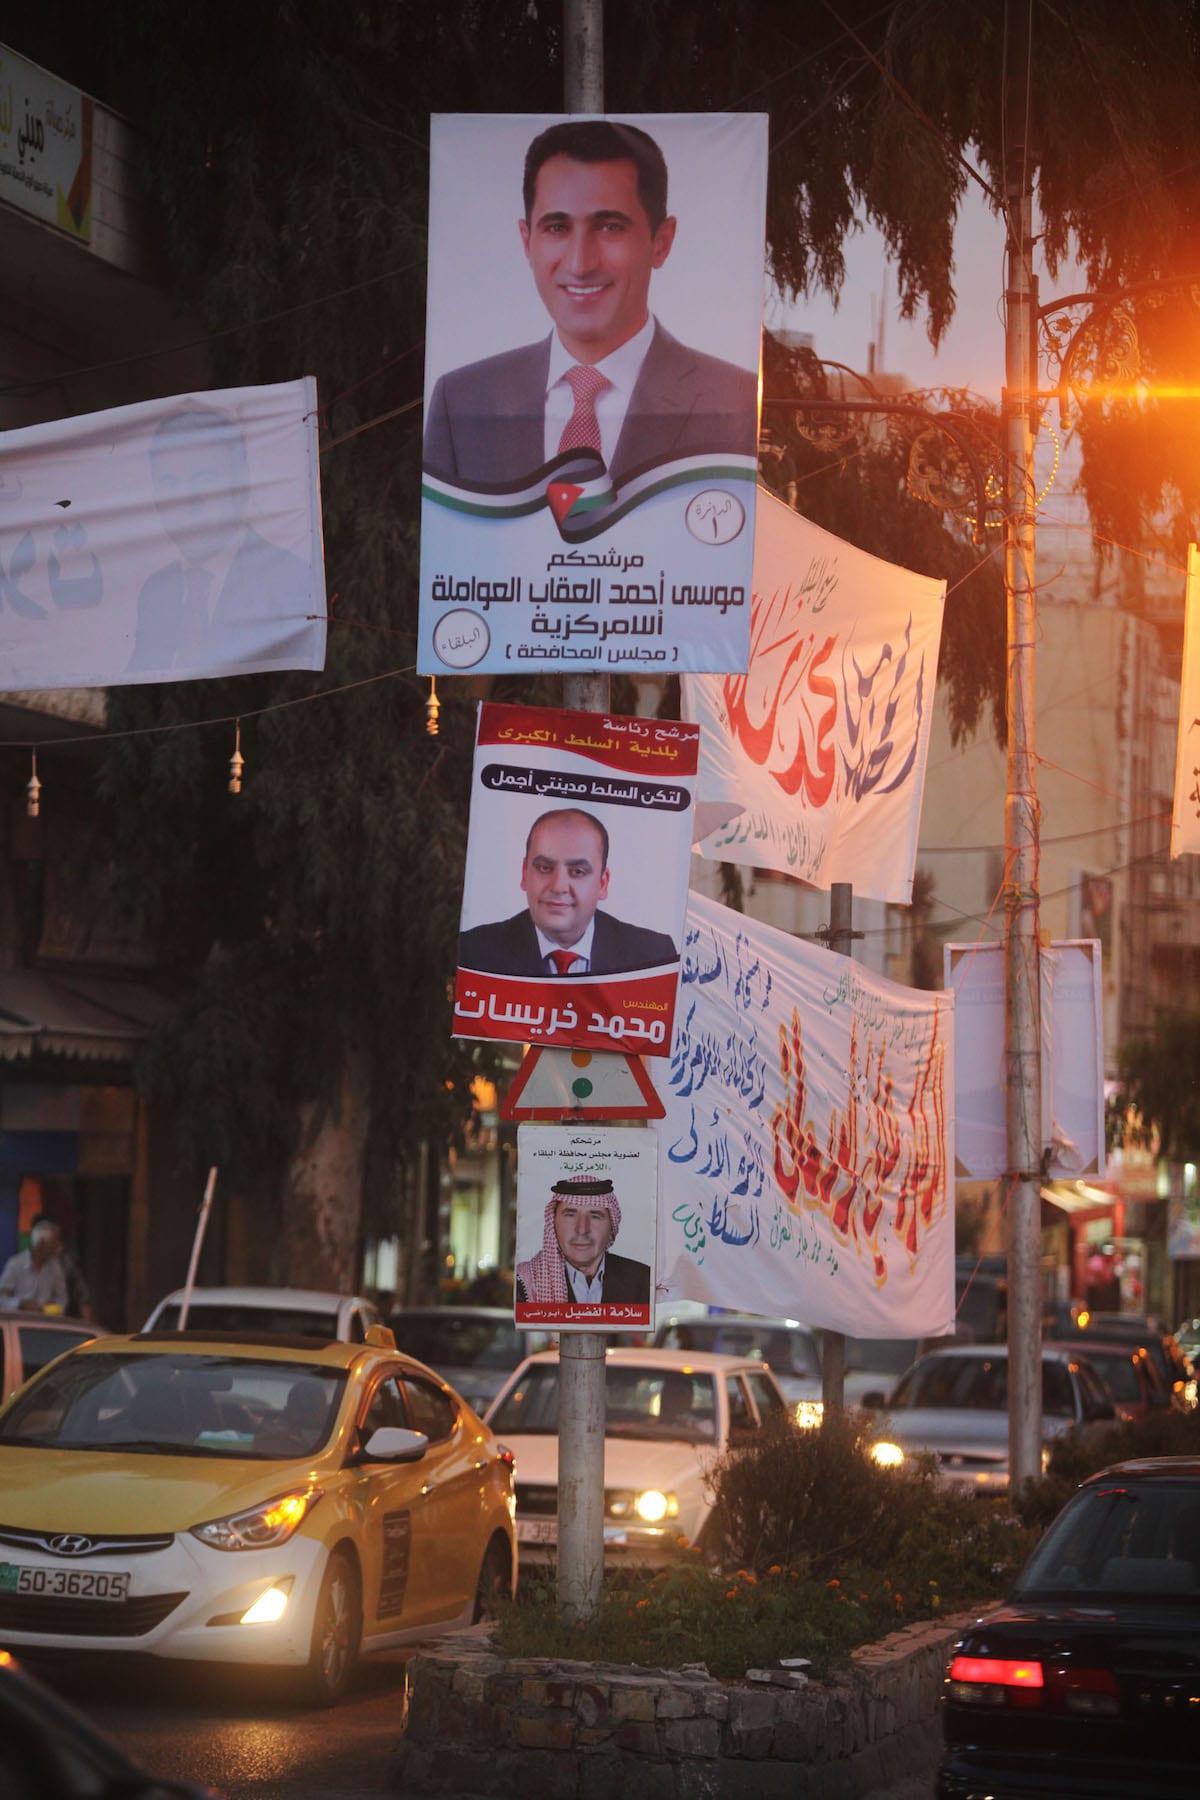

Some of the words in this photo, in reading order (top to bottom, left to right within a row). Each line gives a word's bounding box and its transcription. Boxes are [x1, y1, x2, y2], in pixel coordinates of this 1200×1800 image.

[695, 499, 732, 520] الدائرة
[547, 548, 644, 571] مرشحكم
[431, 574, 521, 611] العواملة
[529, 576, 600, 610] العقاب
[609, 571, 665, 605] أحمد
[672, 583, 745, 614] موسى
[441, 626, 481, 650] البلقاء
[608, 646, 666, 663] مجلس
[497, 728, 557, 745] الكبرى
[564, 734, 620, 750] السلط
[654, 726, 699, 741] مرشح
[629, 740, 679, 760] بلدية
[491, 770, 533, 789] أجمل
[535, 776, 587, 797] مدينتي
[590, 781, 638, 799] السلط
[640, 790, 682, 804] لتكن
[454, 990, 578, 1036] خريسات
[587, 1012, 666, 1044] محمد
[570, 1137, 601, 1146] مرشحكم
[533, 1149, 556, 1159] البلقاء
[558, 1149, 588, 1158] محافظة
[589, 1151, 611, 1159] مجلس
[613, 1151, 640, 1160] لعضوية
[706, 1193, 761, 1247] السلط
[565, 1306, 606, 1319] الفضيل
[609, 1306, 643, 1318] سلامة
[19, 1570, 123, 1598] 50-36205
